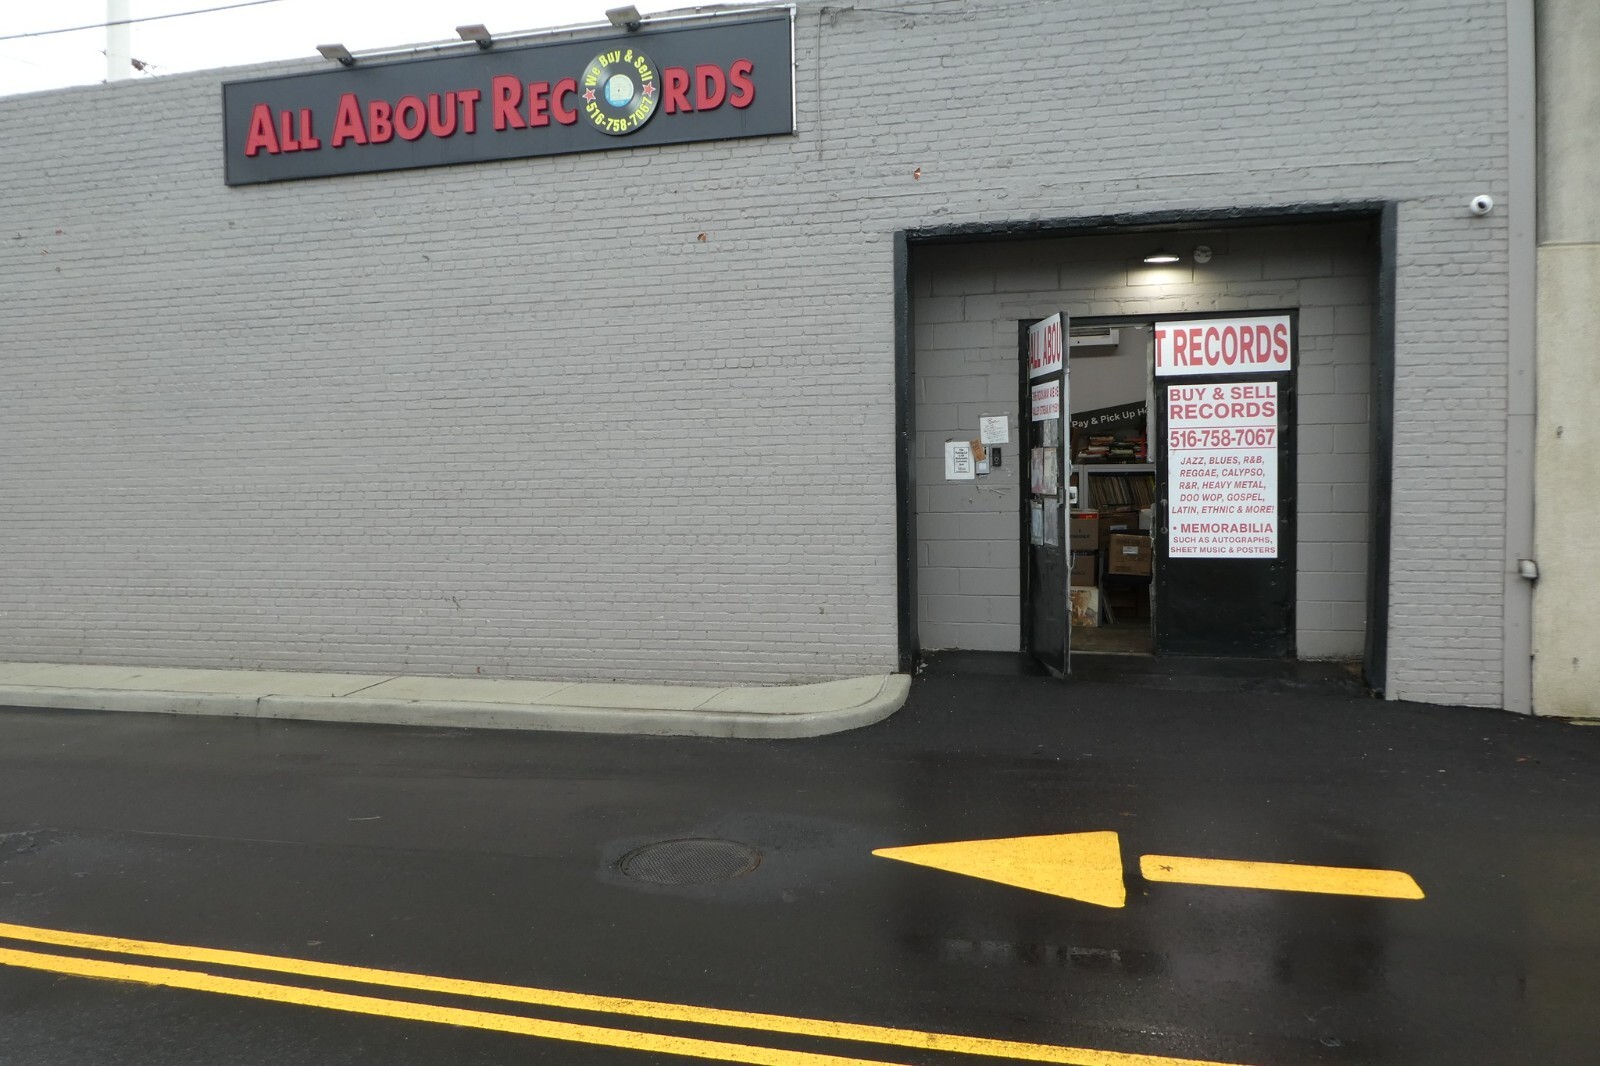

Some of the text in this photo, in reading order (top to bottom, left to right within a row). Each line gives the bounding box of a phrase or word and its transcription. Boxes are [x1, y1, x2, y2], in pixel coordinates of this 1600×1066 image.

[585, 49, 653, 86] We Buy & Sell
[586, 96, 653, 132] 516-758-7067
[1155, 323, 1288, 367] T RECORDS
[1169, 386, 1276, 402] BUY & SELL
[1170, 401, 1276, 420] RECORDS
[1071, 420, 1089, 428] Pay
[1091, 417, 1099, 425] &
[1100, 413, 1121, 423] Pick
[1122, 410, 1136, 420] Up
[1170, 428, 1276, 448] 516-758-7067
[1180, 455, 1265, 466] JAZZ, BLUES, R&B,
[1179, 468, 1265, 478] REGGAE, CALYPSO,
[1179, 480, 1266, 490] R&R, HEAVY METAL,
[1180, 493, 1265, 503] DOO WOP, GOSPEL,
[1171, 505, 1275, 515] LATIN, ETHNIC & MORE!
[1180, 523, 1274, 533] MEMORABILIA
[1211, 536, 1273, 544] AUTOGRAPHS,
